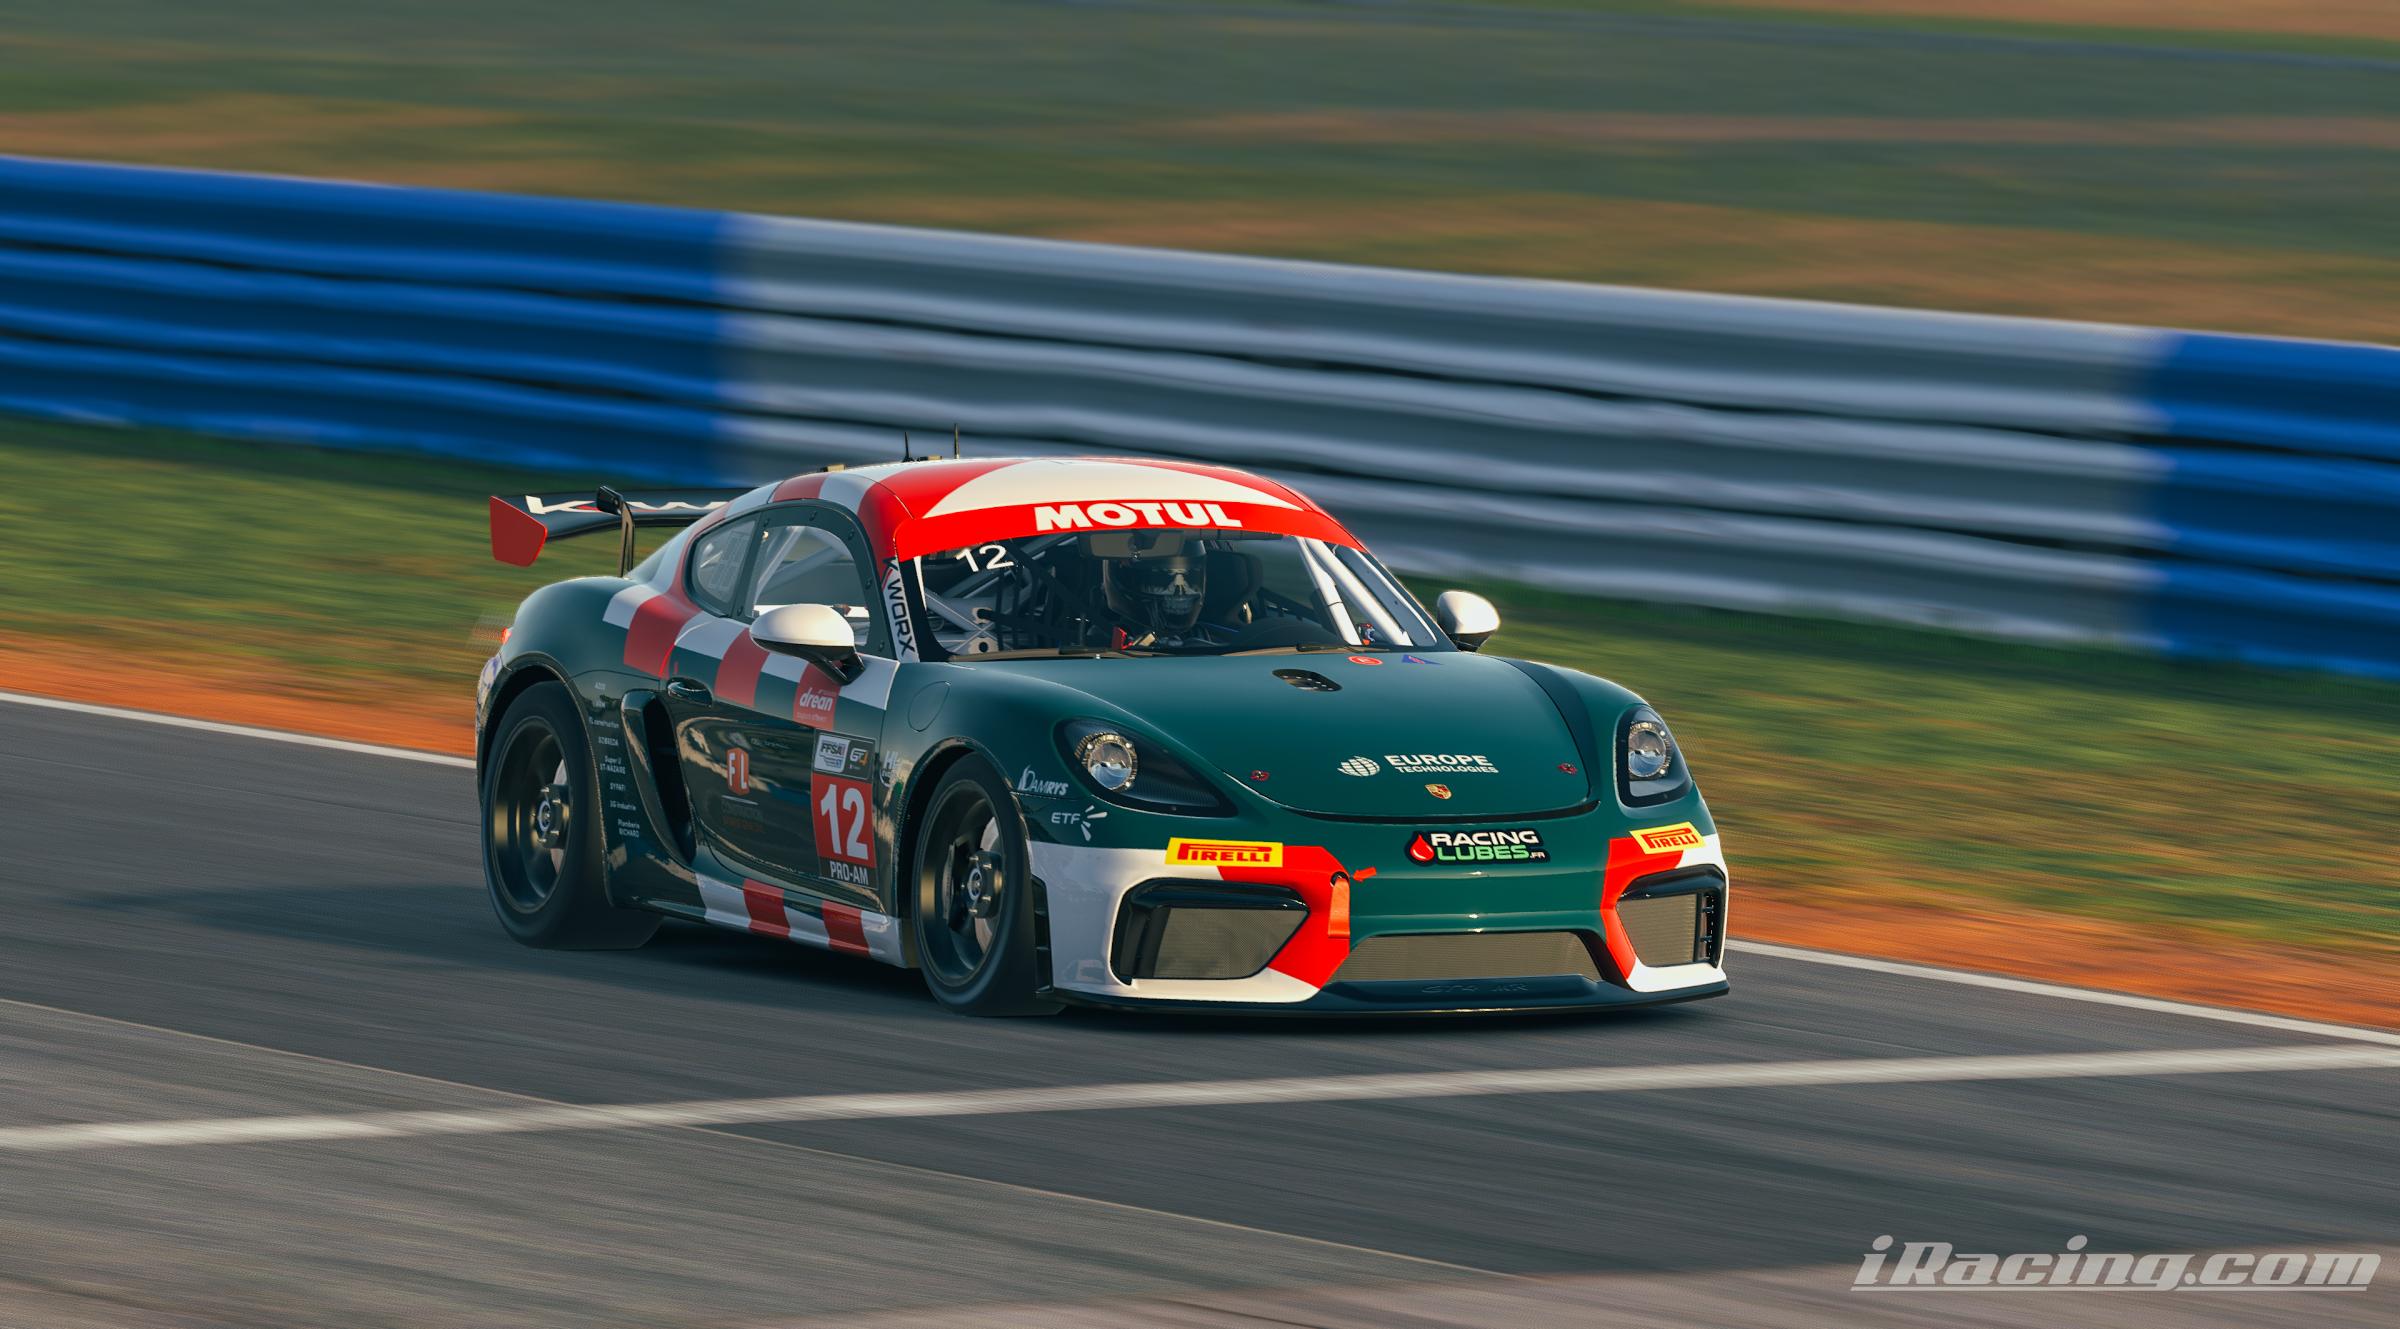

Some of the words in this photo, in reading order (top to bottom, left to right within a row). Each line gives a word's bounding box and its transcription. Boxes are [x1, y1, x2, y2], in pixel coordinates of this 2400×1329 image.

[1034, 502, 1243, 531] MOTUL
[955, 543, 1015, 573] 12
[887, 578, 916, 657] WORX
[1384, 754, 1494, 766] EUROPE
[1394, 766, 1499, 774] TECHNOLOGIES
[820, 783, 869, 860] 12
[1051, 812, 1081, 825] ETF
[1431, 830, 1530, 847] RACING
[1641, 827, 1699, 849] PIRELLI
[1177, 842, 1272, 863] PIRELLI
[829, 860, 869, 886] PRO-AM
